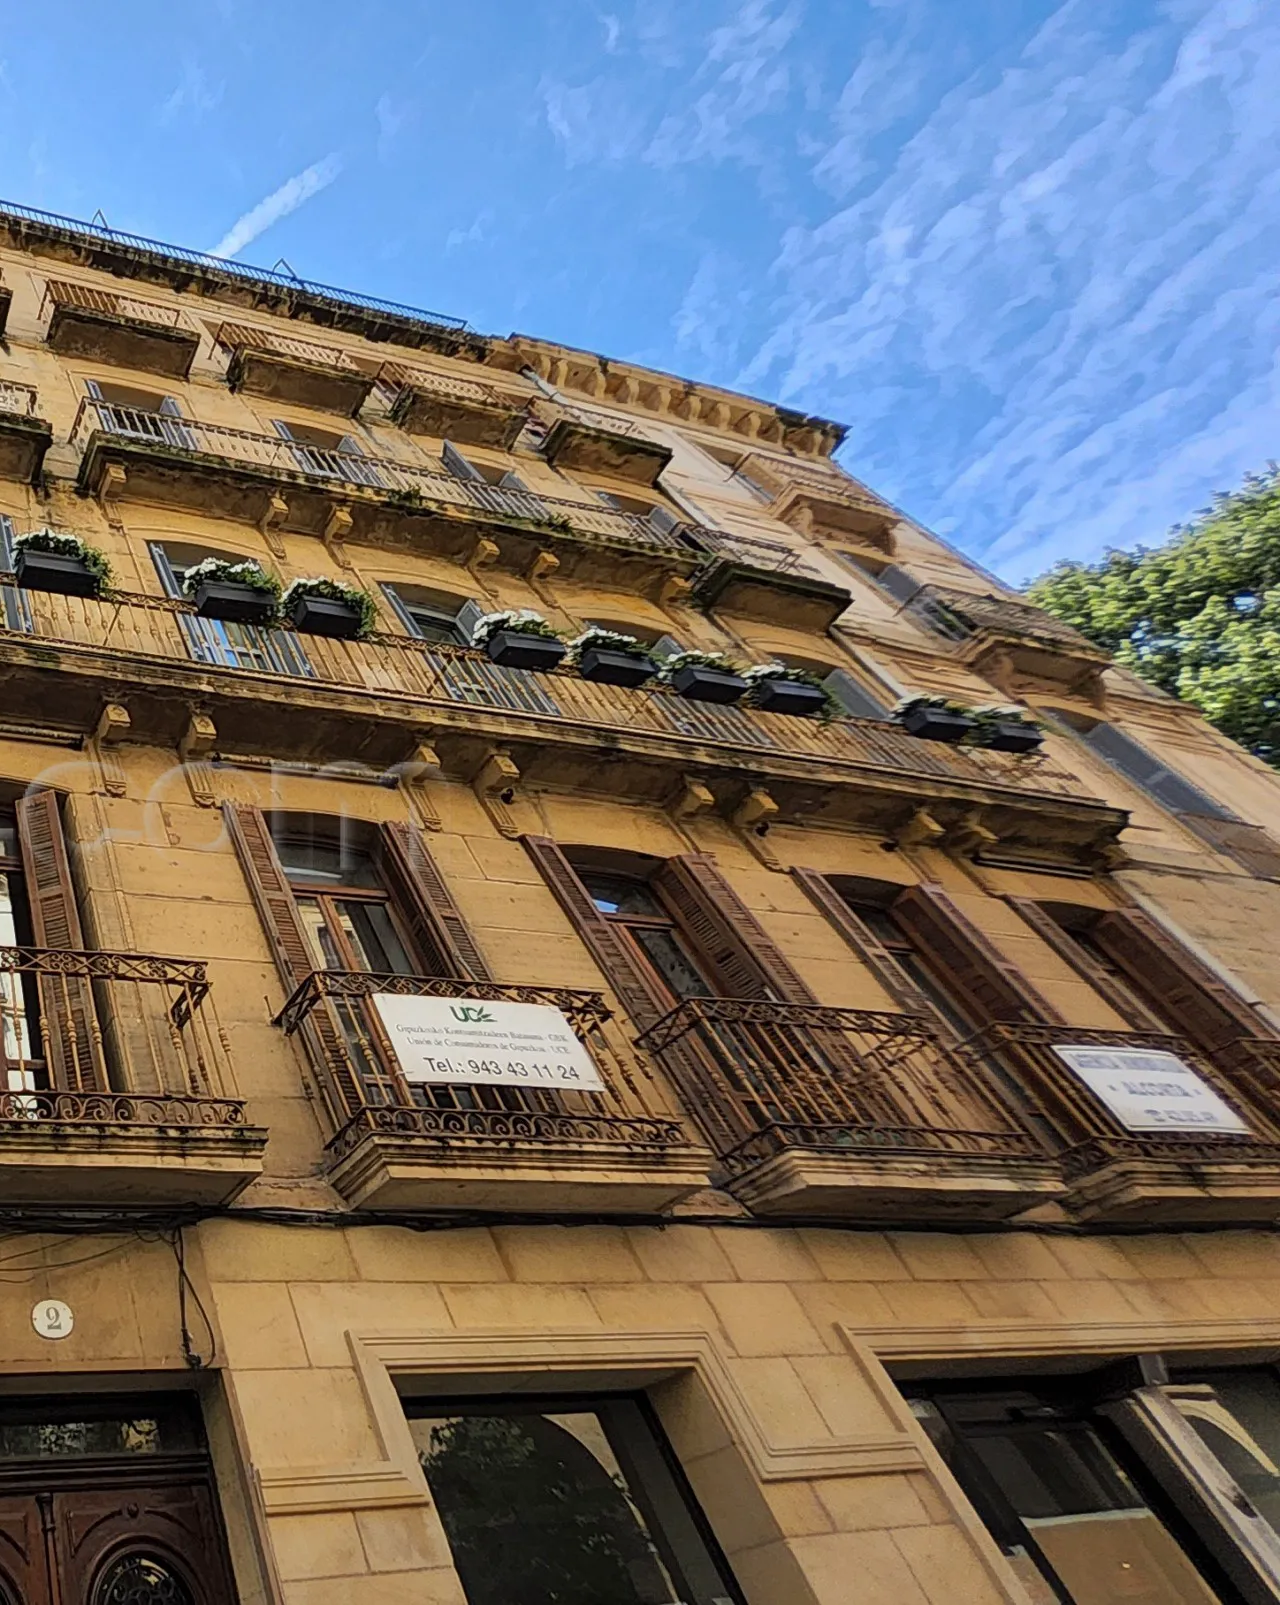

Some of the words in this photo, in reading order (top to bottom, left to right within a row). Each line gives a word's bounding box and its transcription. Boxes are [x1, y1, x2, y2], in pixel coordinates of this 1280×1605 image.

[423, 1057, 466, 1073] Tel.:
[467, 1060, 502, 1075] 943
[507, 1062, 529, 1077] 43
[531, 1064, 553, 1079] 11
[556, 1065, 580, 1080] 24
[45, 1306, 62, 1330] 2
